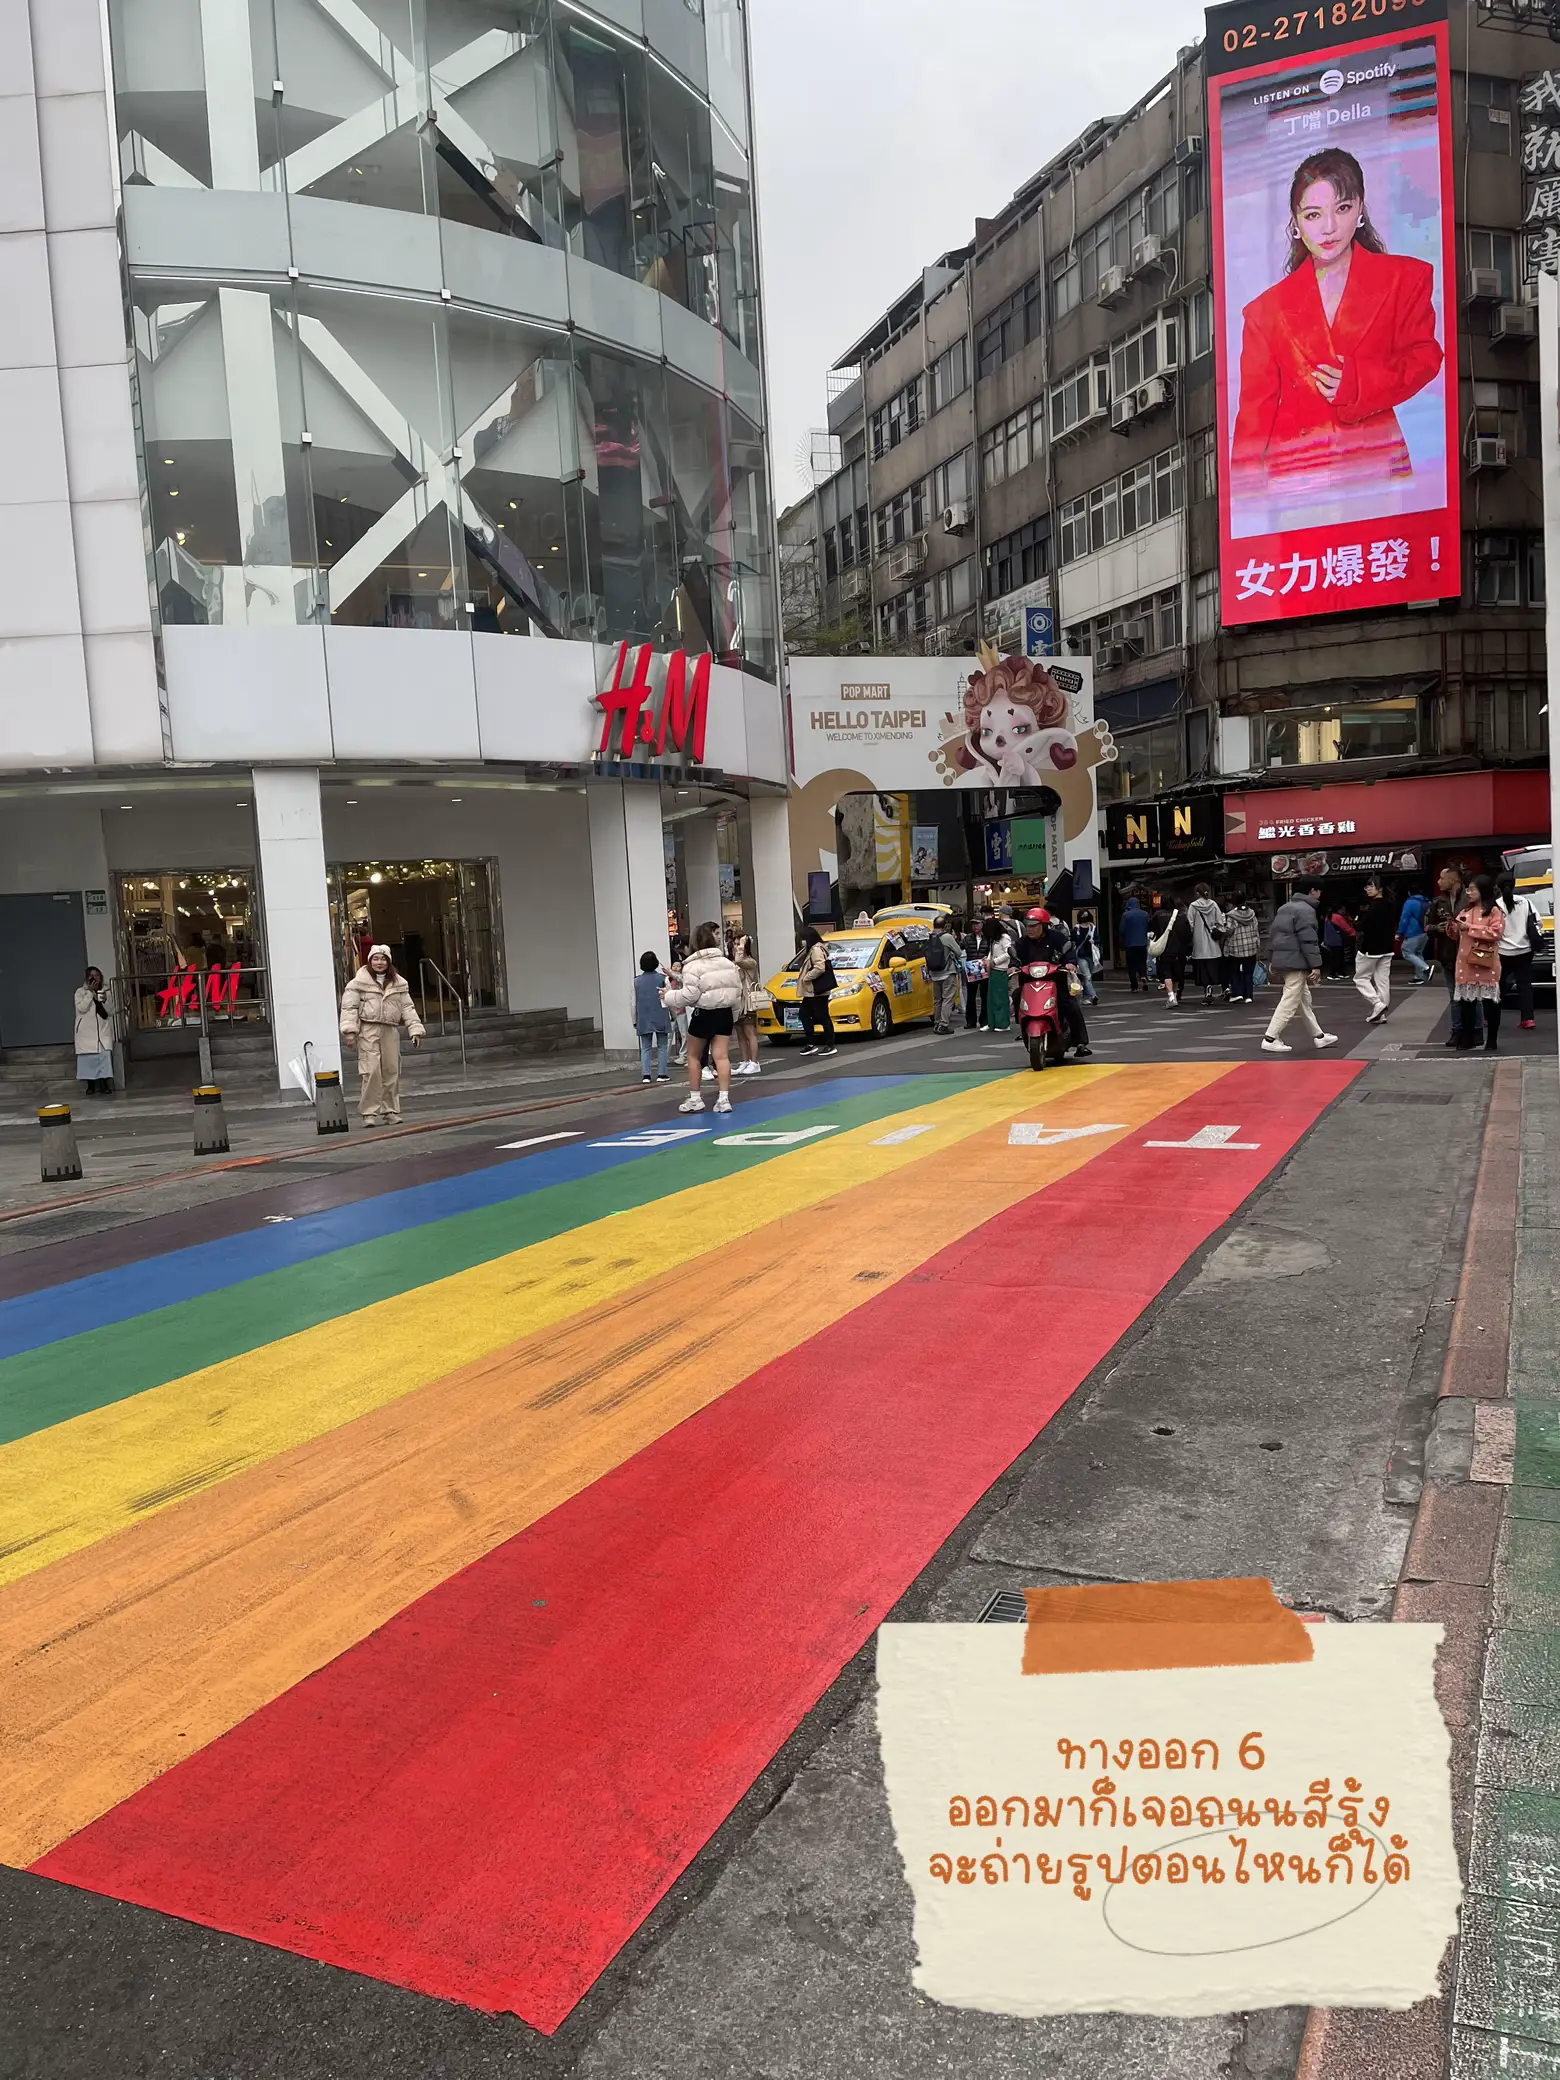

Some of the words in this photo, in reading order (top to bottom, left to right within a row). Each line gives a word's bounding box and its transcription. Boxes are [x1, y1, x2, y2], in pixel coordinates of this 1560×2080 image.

[1346, 62, 1396, 84] Spotify
[1253, 90, 1290, 105] LISTEN
[1293, 85, 1310, 97] ON
[1283, 109, 1322, 136] 丁噹
[1327, 103, 1371, 125] Della
[1235, 536, 1441, 601] 女力爆發！
[595, 639, 711, 764] H&M
[843, 686, 861, 698] POP
[863, 686, 888, 698] MART
[810, 710, 869, 730] HELLO
[871, 709, 926, 729] TAIPEI
[826, 732, 863, 741] WELCOME
[1051, 834, 1059, 870] MART
[1340, 856, 1371, 865] TAIWAN
[1374, 851, 1394, 864] NO.1
[158, 962, 241, 1018] H&M
